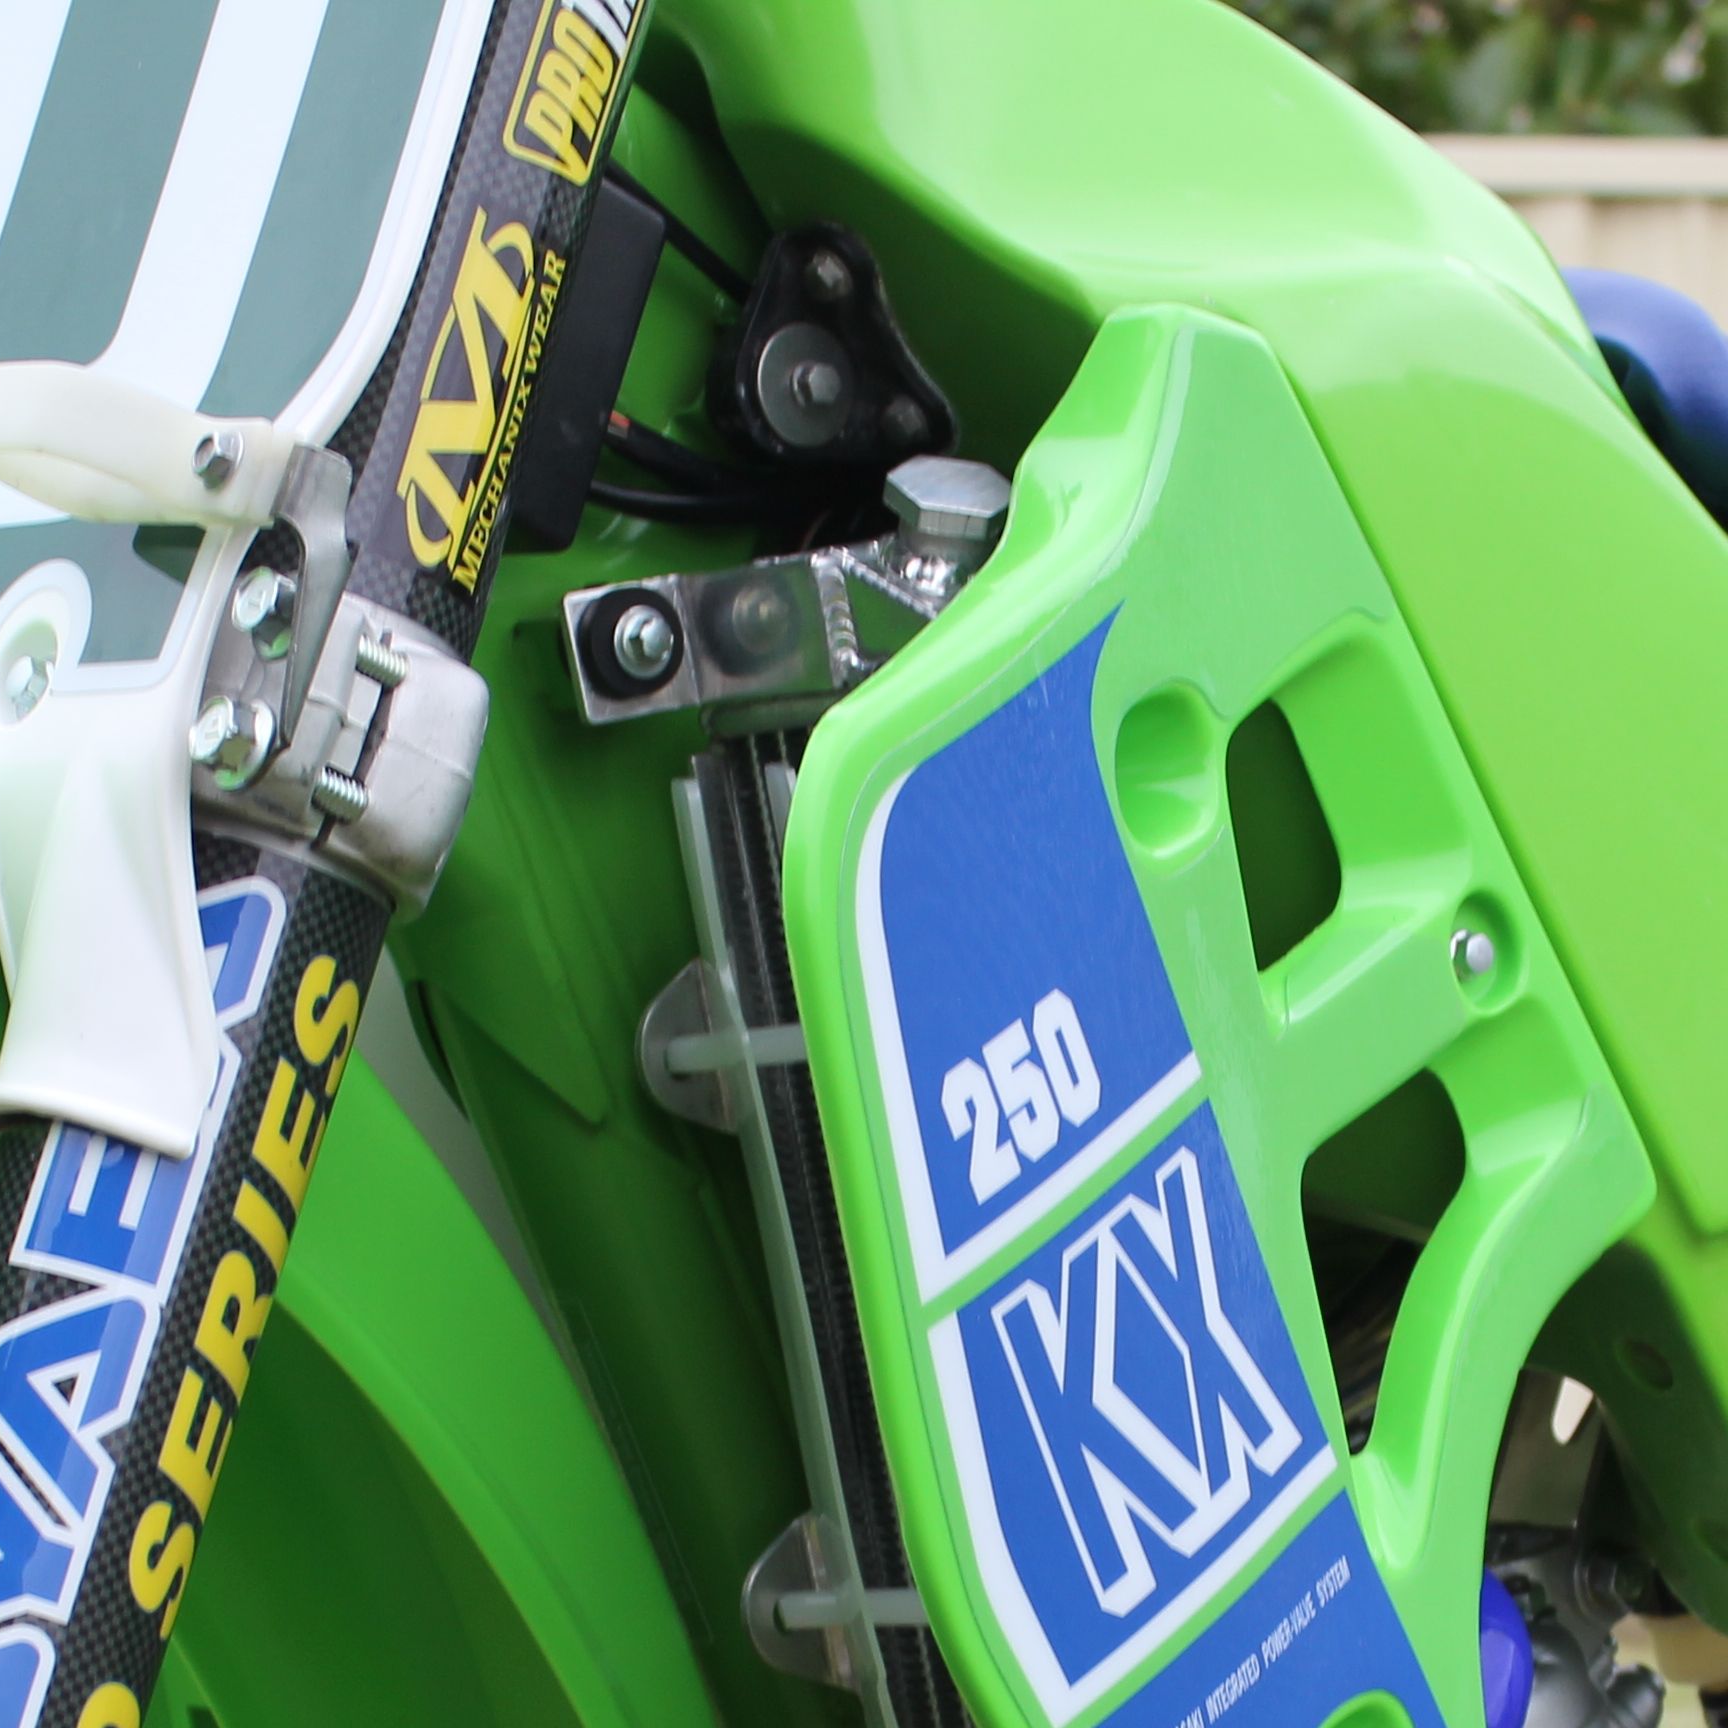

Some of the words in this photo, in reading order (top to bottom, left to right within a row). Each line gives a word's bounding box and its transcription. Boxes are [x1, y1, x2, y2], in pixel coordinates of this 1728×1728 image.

[452, 380, 532, 595] MECHANIX
[523, 248, 567, 376] WEAR
[941, 989, 1100, 1206] 250
[128, 955, 362, 1640] SERIES
[990, 1147, 1302, 1618] KX
[1205, 1653, 1261, 1725] INTEGRATED
[1260, 1591, 1317, 1669] POWER-VALVE
[1316, 1555, 1351, 1608] SYSTEM
